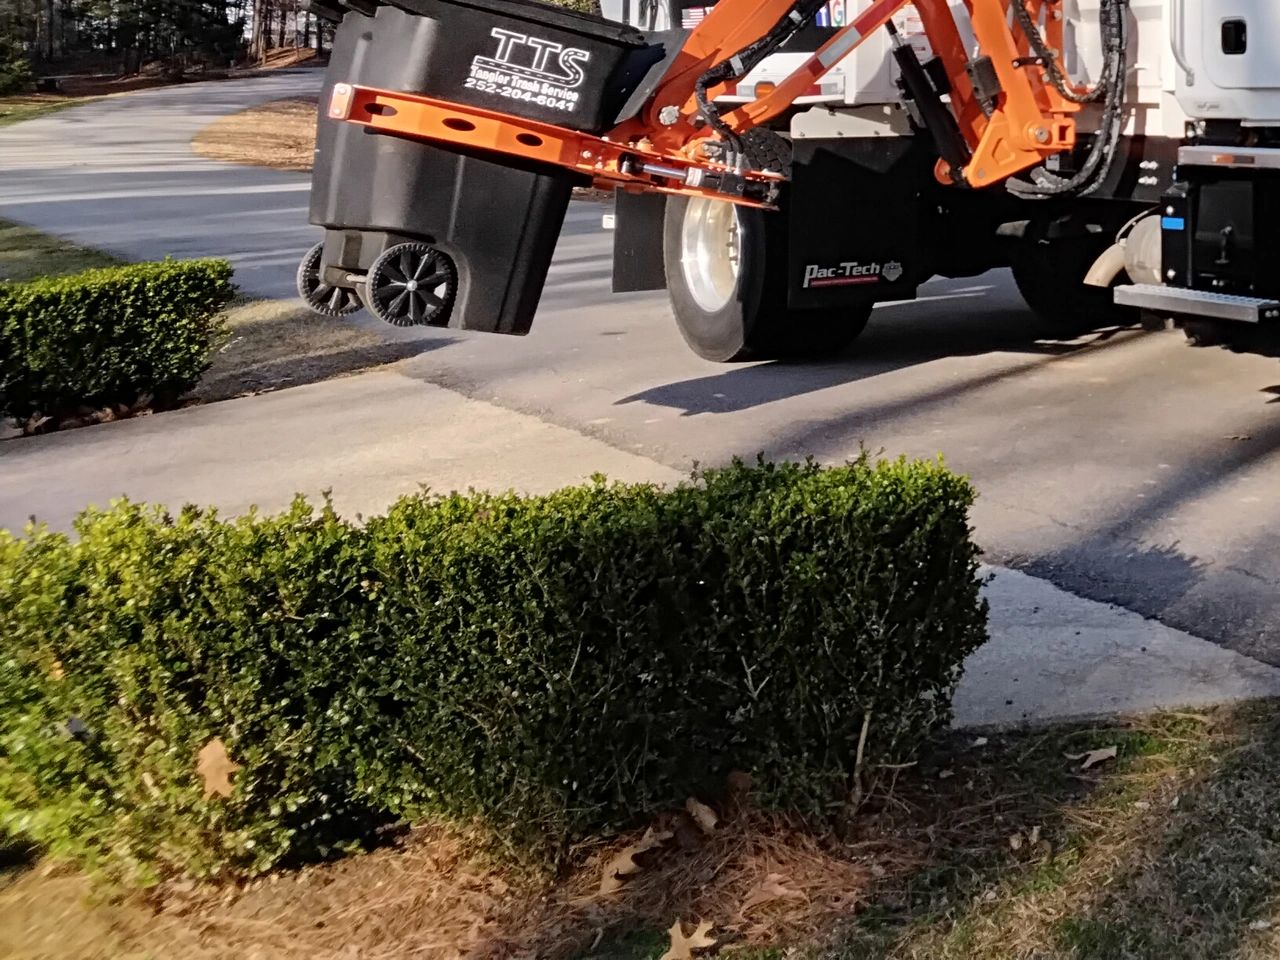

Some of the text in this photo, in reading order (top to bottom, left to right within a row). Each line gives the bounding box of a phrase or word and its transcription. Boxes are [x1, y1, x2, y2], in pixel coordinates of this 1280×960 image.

[480, 27, 590, 88] TTS
[470, 65, 579, 102] Tangler Trash Service
